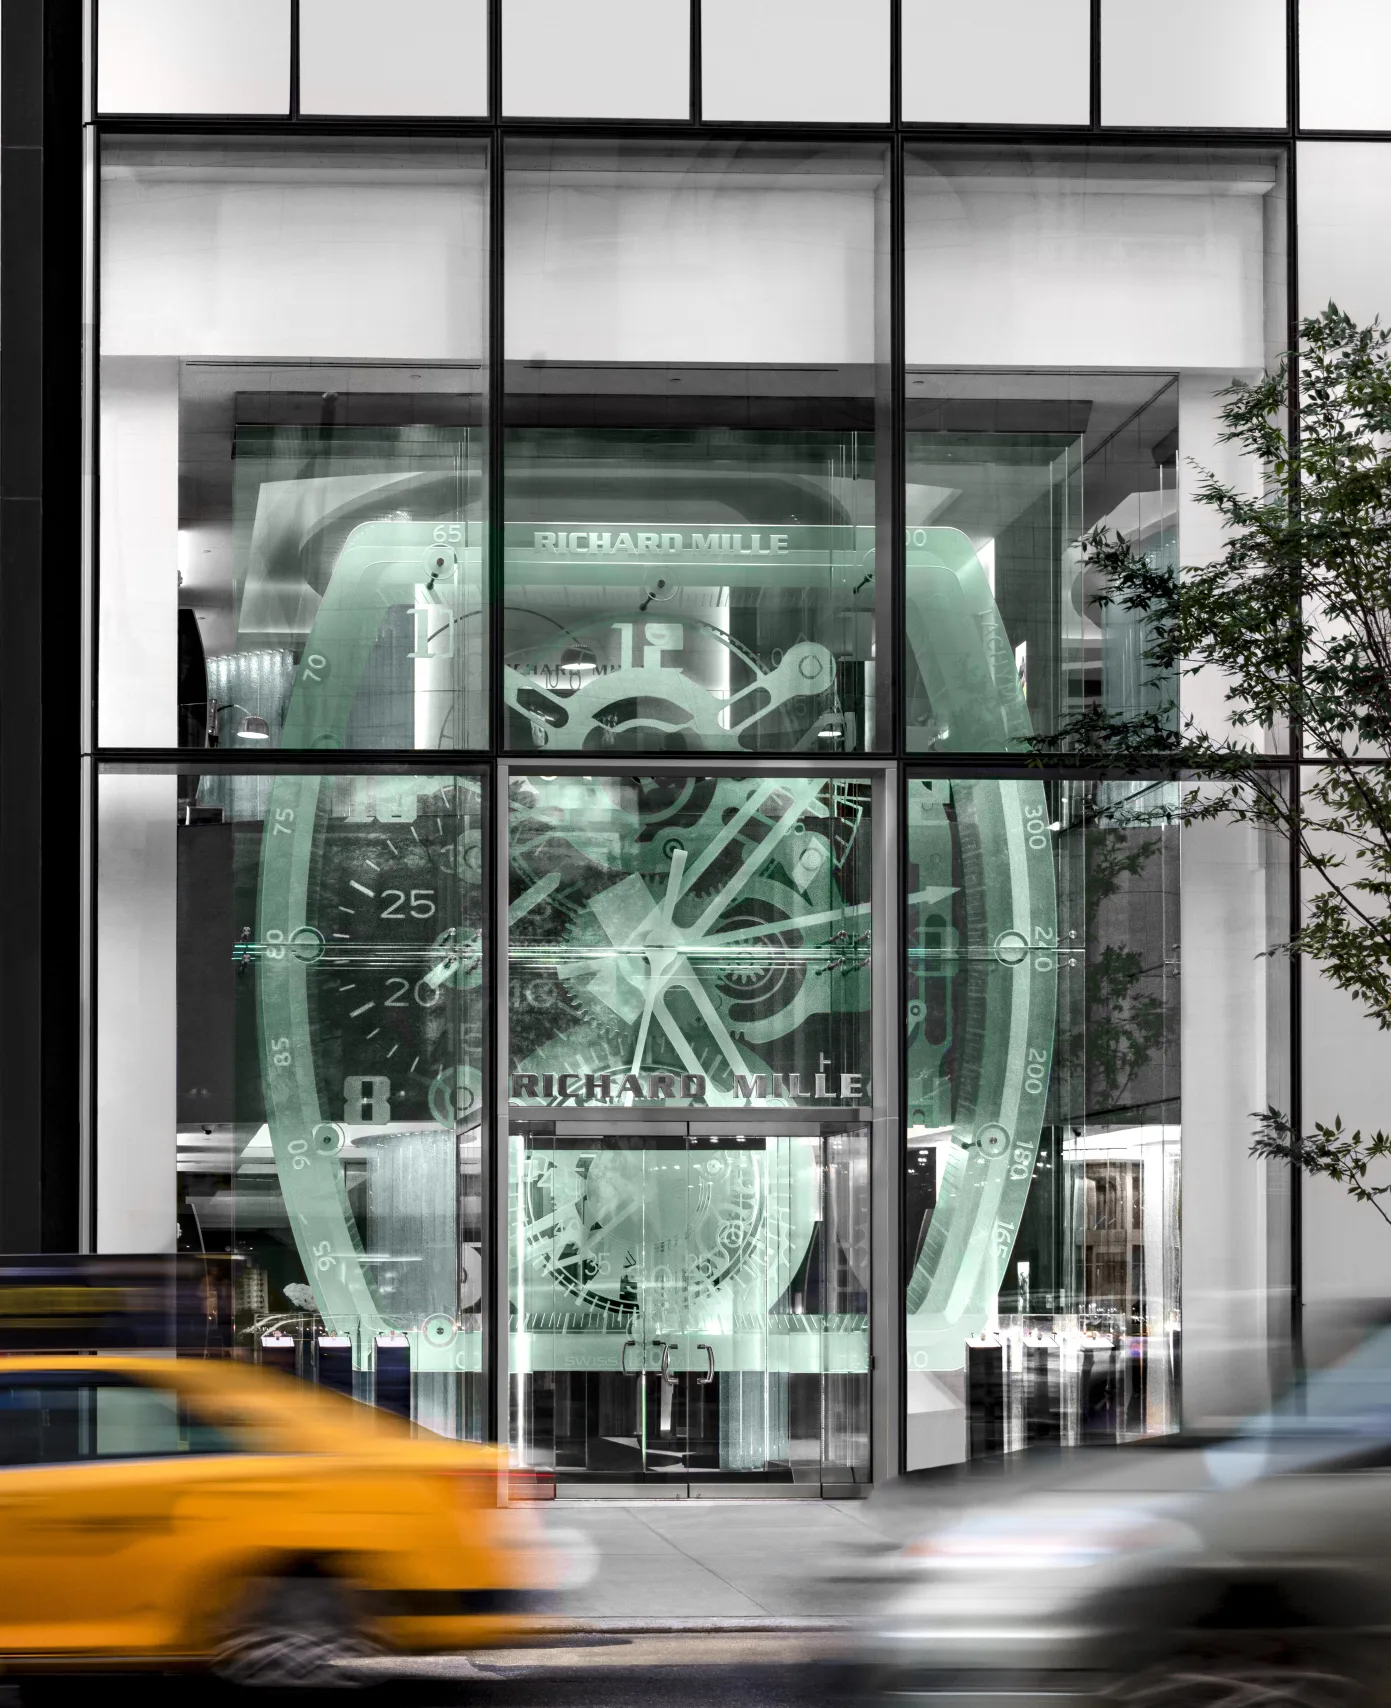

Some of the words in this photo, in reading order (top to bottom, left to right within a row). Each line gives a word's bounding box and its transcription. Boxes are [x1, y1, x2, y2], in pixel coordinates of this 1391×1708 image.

[433, 525, 462, 543] 65
[534, 531, 684, 554] RICHARD
[691, 533, 789, 555] MILLE
[302, 654, 327, 682] 70
[272, 807, 295, 837] 75
[1024, 804, 1047, 850] 300
[380, 889, 436, 919] 25
[266, 928, 286, 960] 80
[384, 977, 440, 1007] 20
[272, 1036, 292, 1067] 85
[511, 1073, 706, 1098] RICHARD
[733, 1073, 863, 1099] MILLE
[1025, 1048, 1047, 1094] 200
[343, 1075, 391, 1126] 8
[288, 1139, 311, 1171] 90
[1010, 1140, 1034, 1181] 180
[990, 1219, 1015, 1259] 165
[313, 1240, 337, 1272] 95
[585, 1253, 611, 1276] 35
